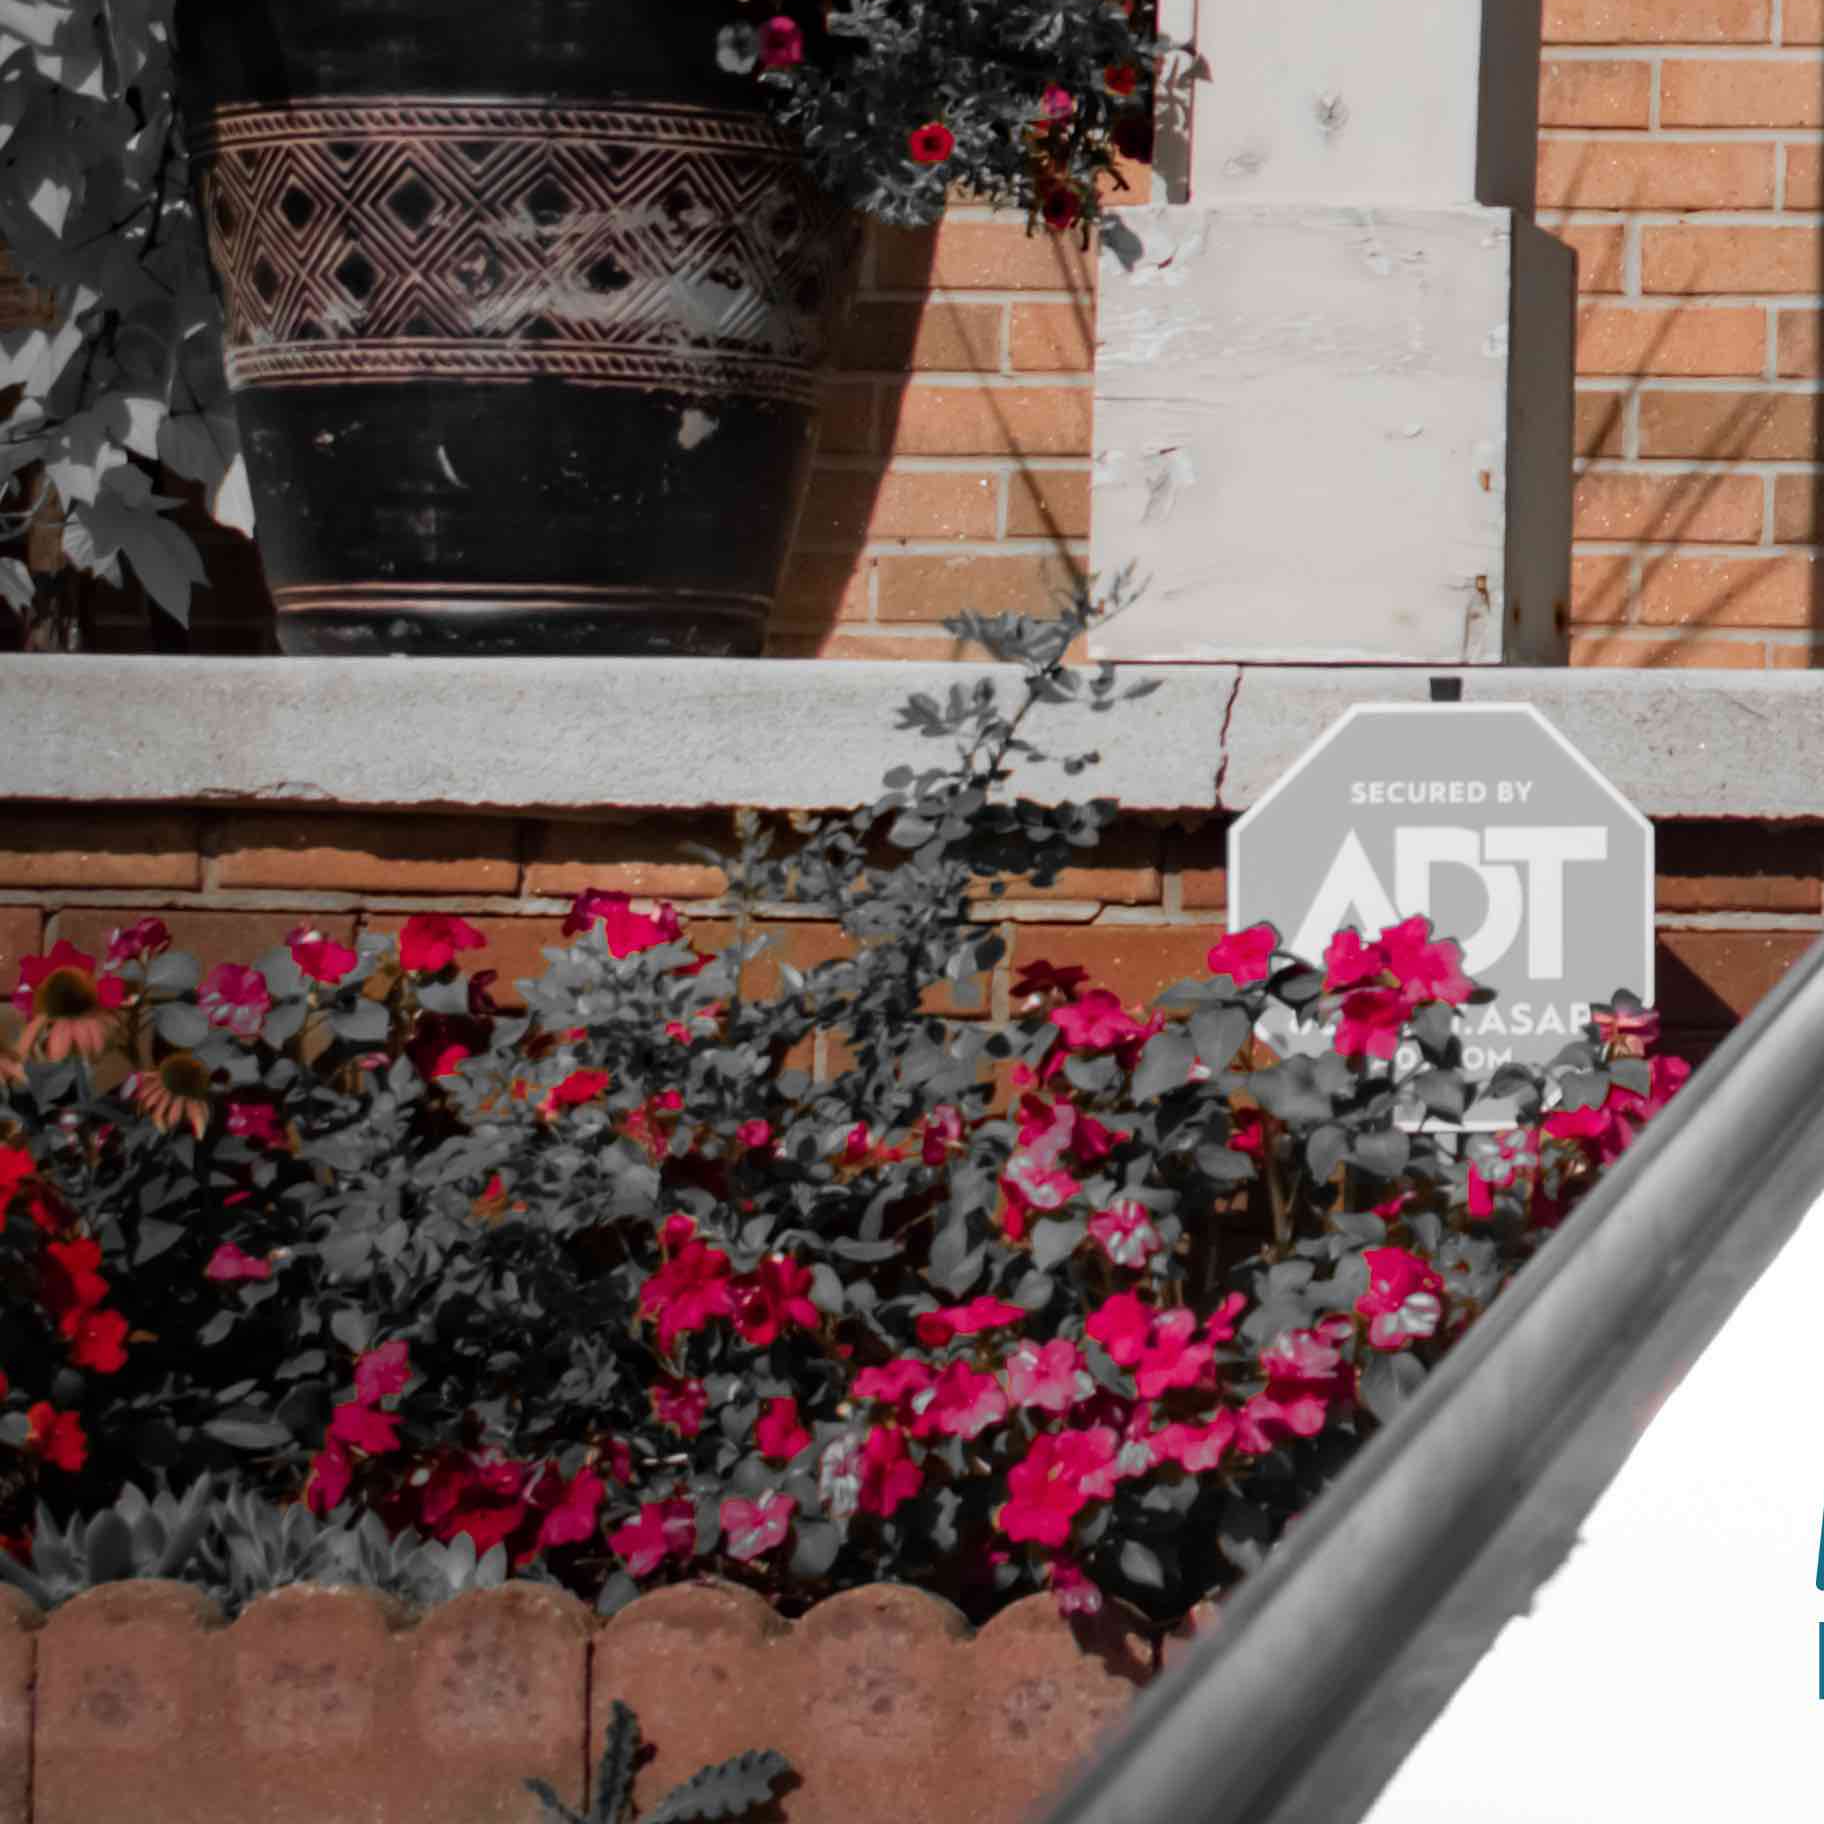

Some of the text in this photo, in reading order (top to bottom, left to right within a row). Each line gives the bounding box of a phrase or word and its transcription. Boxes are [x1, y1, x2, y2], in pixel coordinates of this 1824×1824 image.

[1350, 780, 1534, 805] SECURED BY
[1289, 825, 1608, 980] ADT
